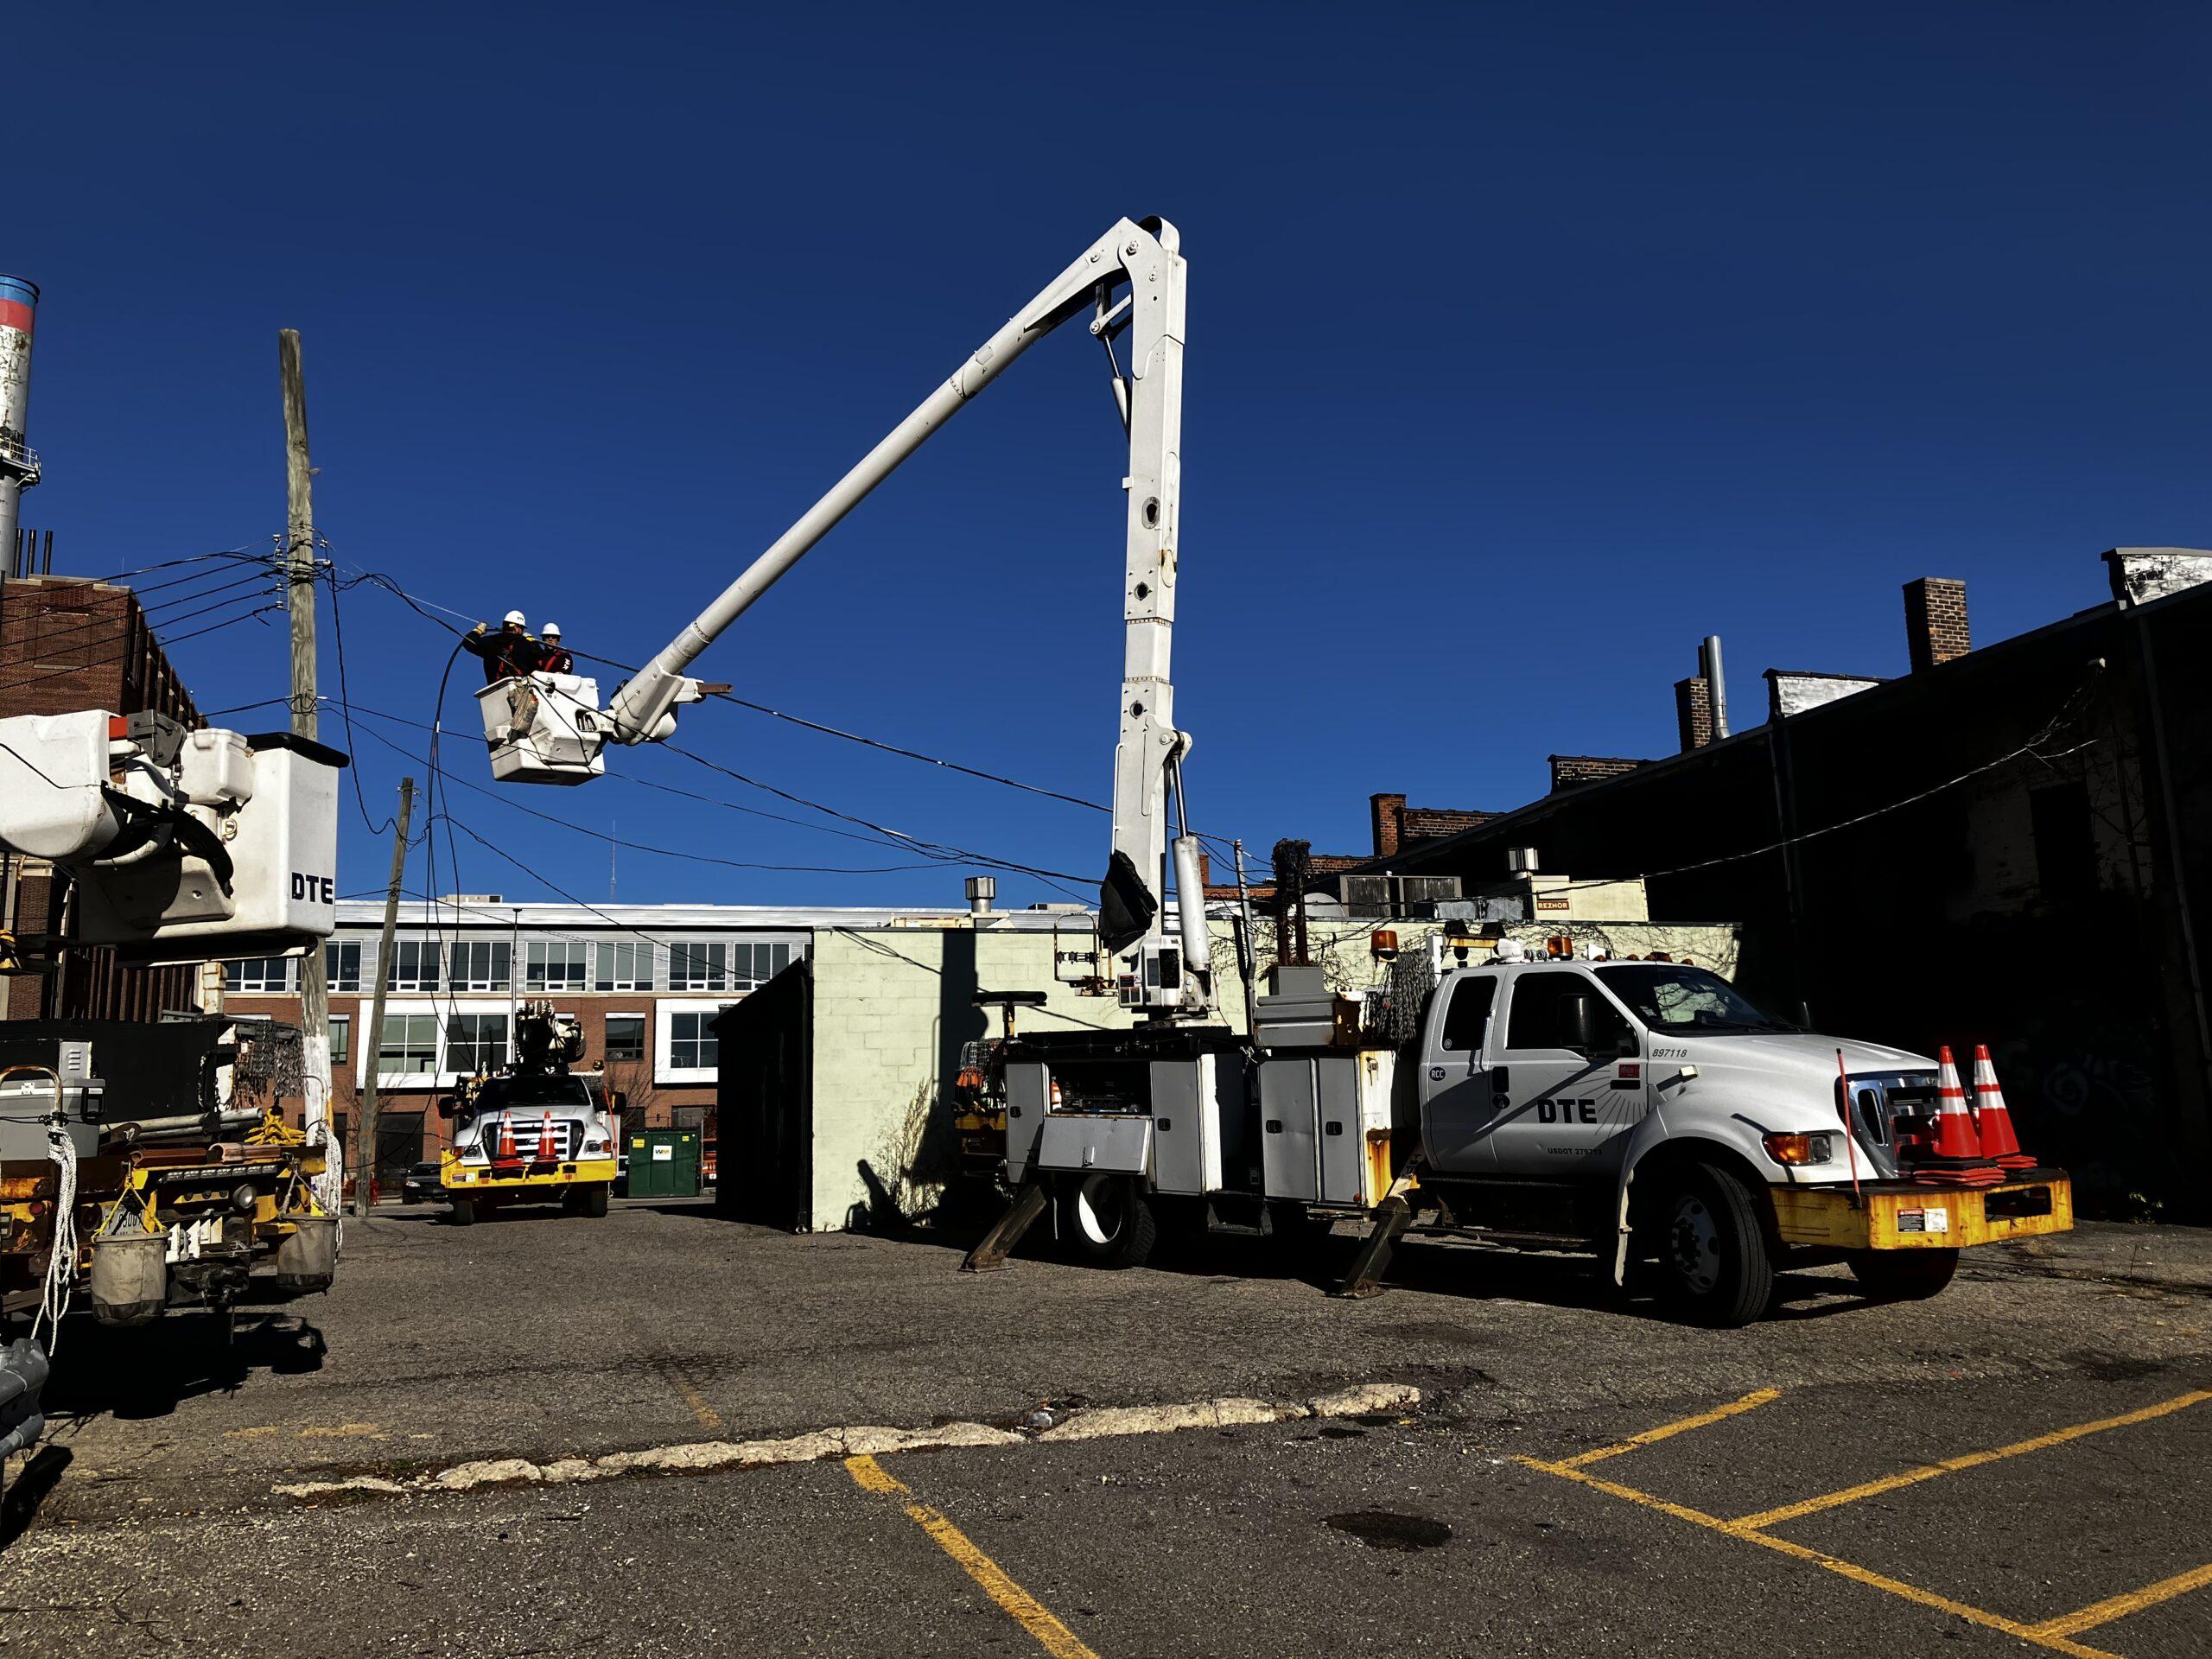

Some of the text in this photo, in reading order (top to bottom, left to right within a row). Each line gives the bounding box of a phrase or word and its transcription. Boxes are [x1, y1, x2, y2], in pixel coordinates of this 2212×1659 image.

[291, 872, 334, 905] DTE
[1652, 1048, 1688, 1058] 897118
[1431, 1070, 1445, 1078] RCC
[1537, 1098, 1598, 1124] DTE
